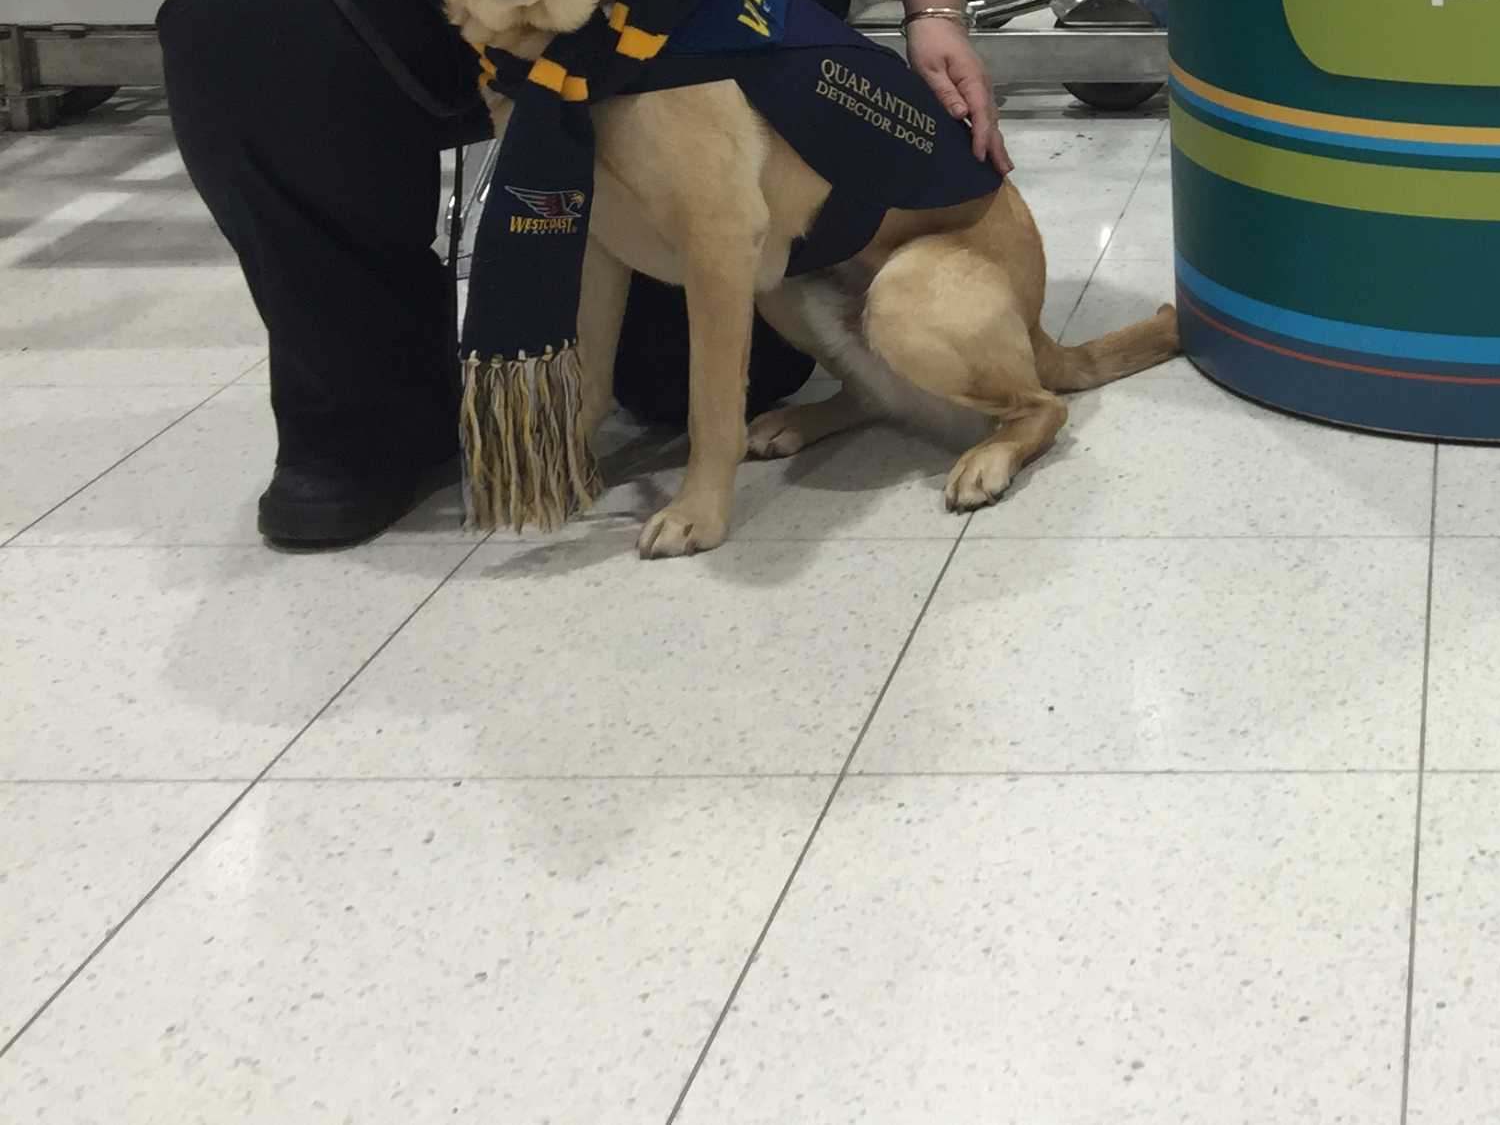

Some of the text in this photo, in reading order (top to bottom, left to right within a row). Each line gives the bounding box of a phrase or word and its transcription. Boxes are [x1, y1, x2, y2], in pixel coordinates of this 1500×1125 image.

[815, 80, 935, 155] DETECTOR DOGS
[820, 59, 937, 136] QUARANTINE
